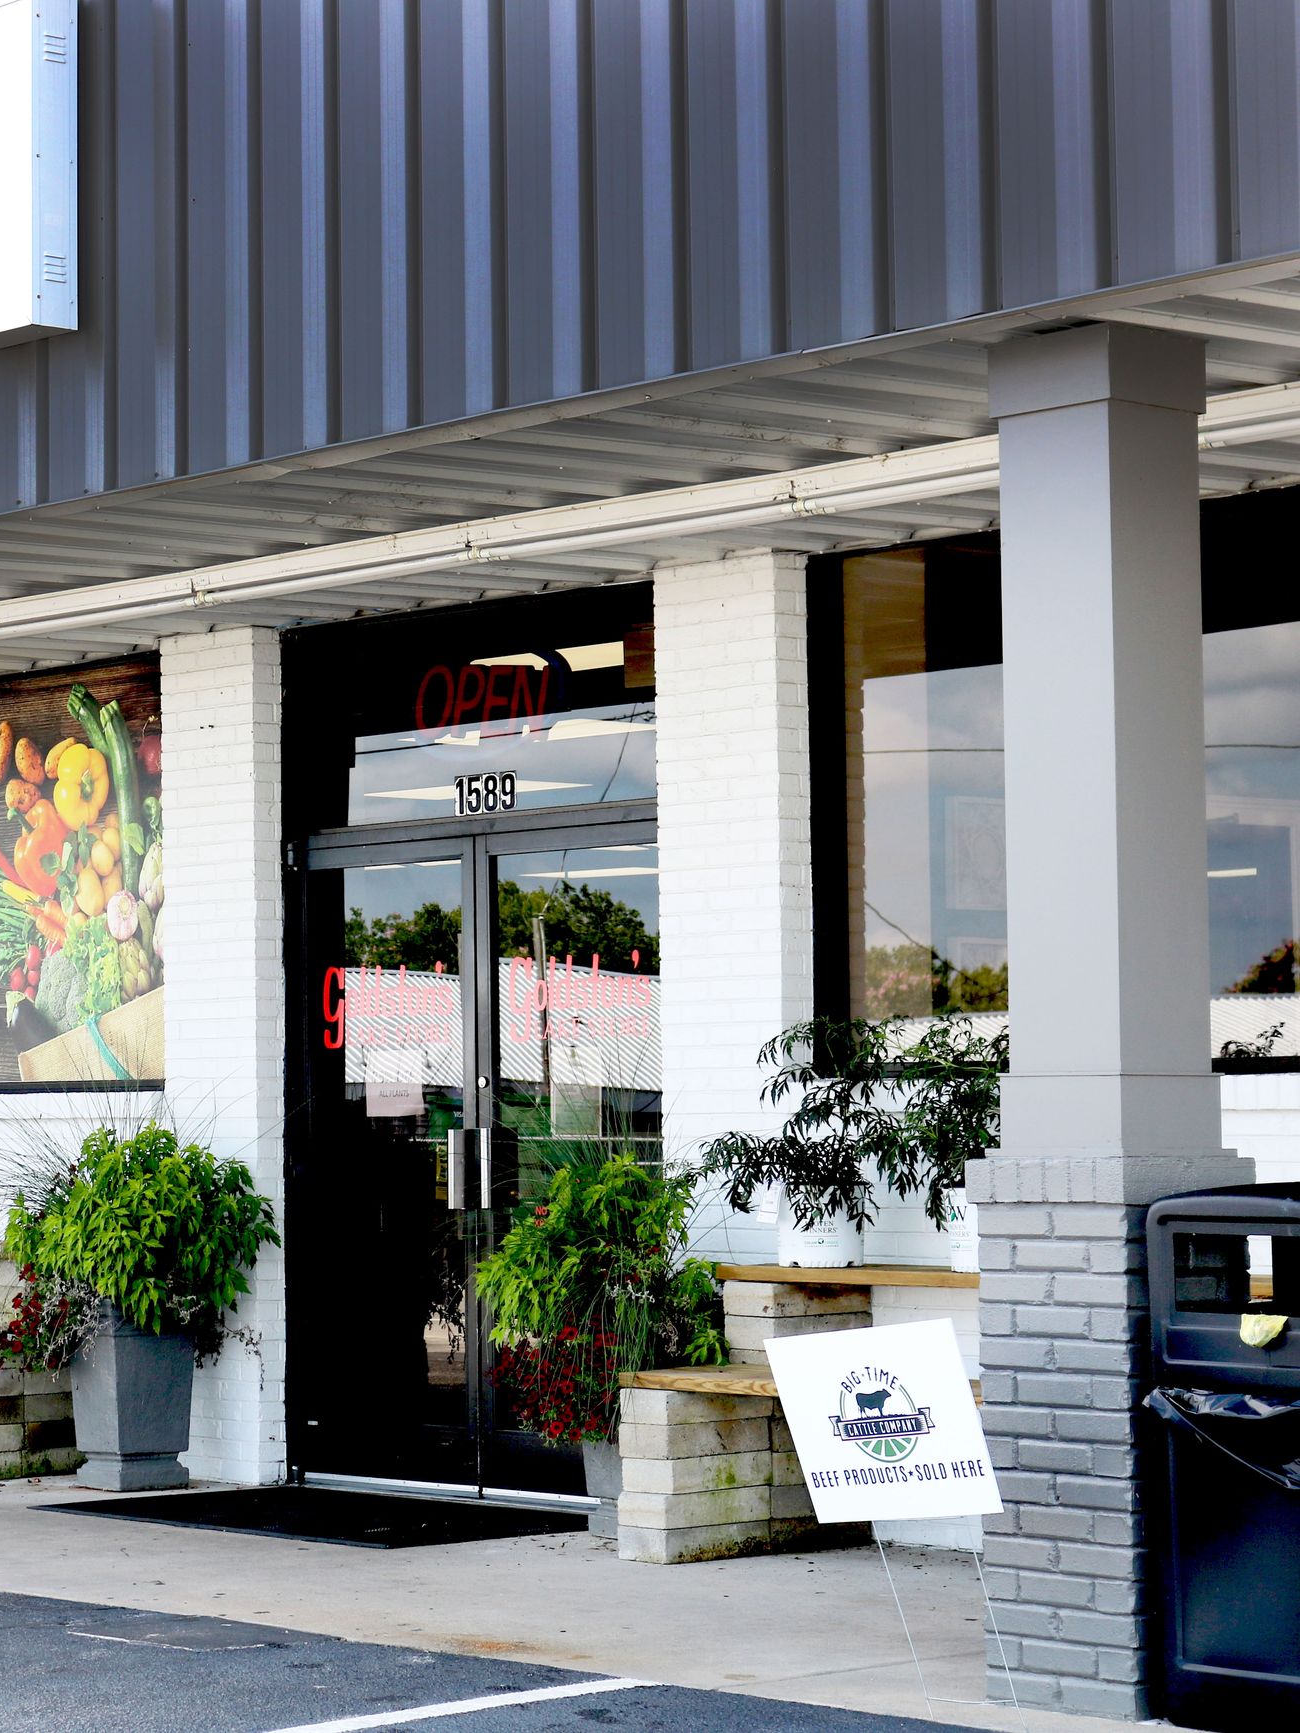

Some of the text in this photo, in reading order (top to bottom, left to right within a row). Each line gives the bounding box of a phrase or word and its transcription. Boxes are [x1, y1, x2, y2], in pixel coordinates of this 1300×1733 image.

[414, 664, 553, 742] OPEN
[455, 771, 517, 816] 1589
[323, 961, 453, 1049] Goldston's
[509, 949, 652, 1043] Goldston's
[535, 1014, 650, 1041] LAKE STORE
[847, 1418, 918, 1437] CATTLE COMPANY
[811, 1459, 986, 1489] BEEF PRODUCTS SOLD HERE
